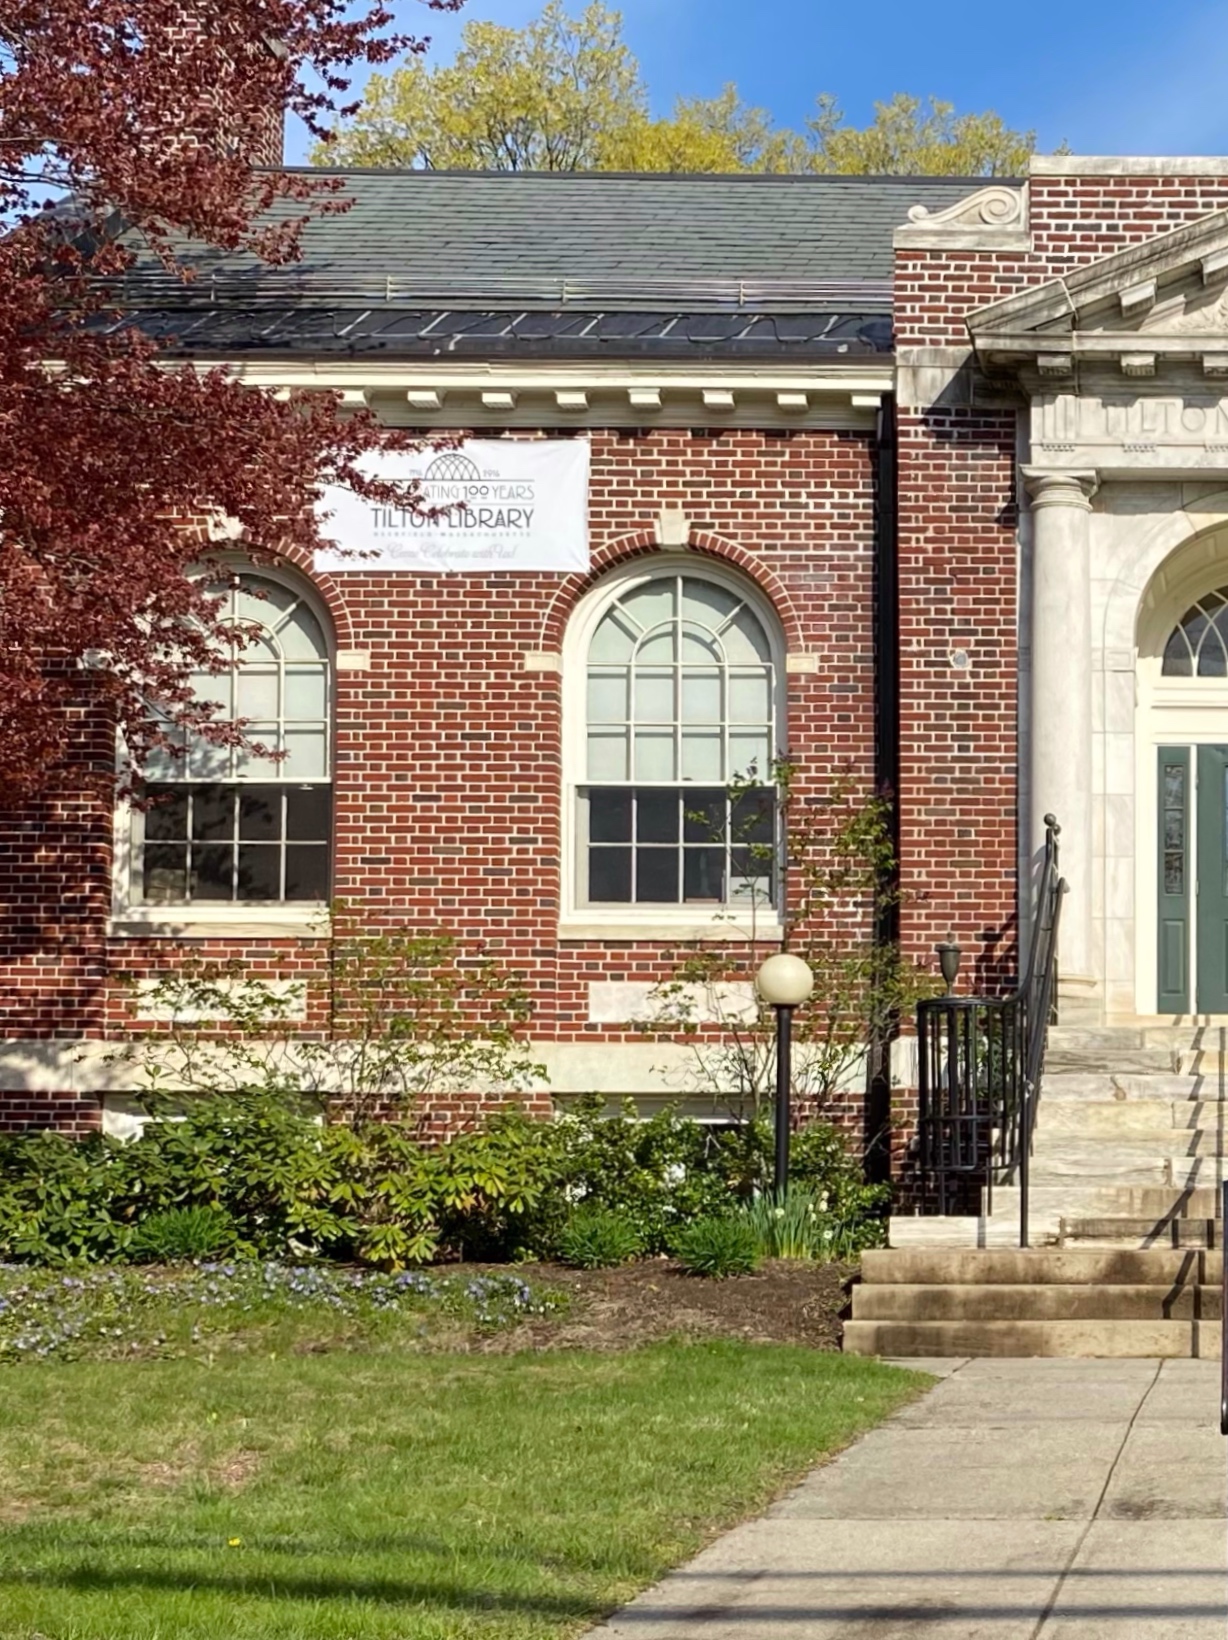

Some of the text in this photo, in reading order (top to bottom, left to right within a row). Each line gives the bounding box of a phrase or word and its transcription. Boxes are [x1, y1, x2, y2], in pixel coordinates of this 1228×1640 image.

[463, 485, 489, 500] 100
[491, 485, 534, 500] YEARS
[370, 508, 534, 528] TILTON LIBRARY
